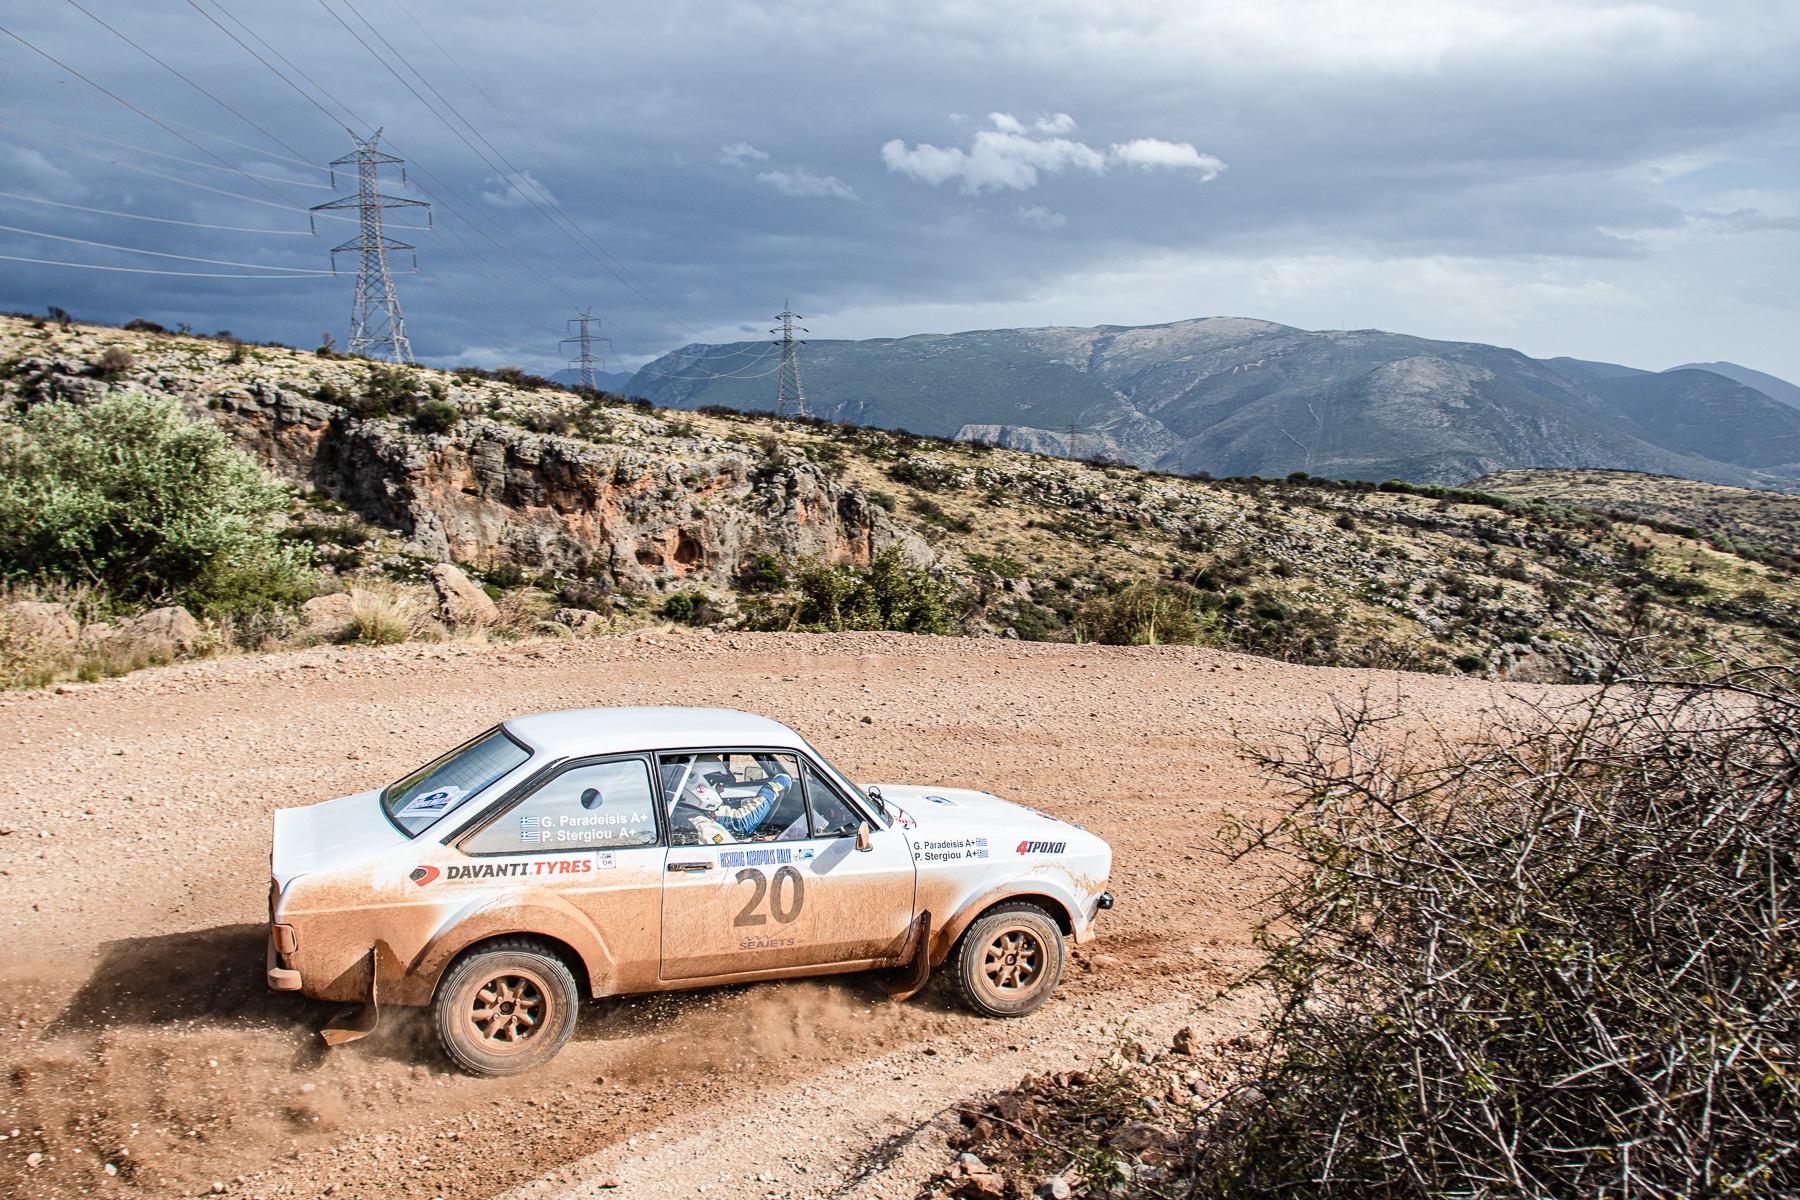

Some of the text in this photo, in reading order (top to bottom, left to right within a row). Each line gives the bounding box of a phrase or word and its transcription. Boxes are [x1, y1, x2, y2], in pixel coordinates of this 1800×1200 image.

[541, 812, 648, 828] G. Paradeisis A+
[542, 827, 636, 843] P. Stergiou A+
[913, 838, 976, 850] G. Paradeisis A+
[777, 848, 792, 864] RALLY
[915, 849, 977, 862] P. Stergiou A+
[733, 866, 805, 928] 20
[739, 938, 795, 950] SEAJETS
